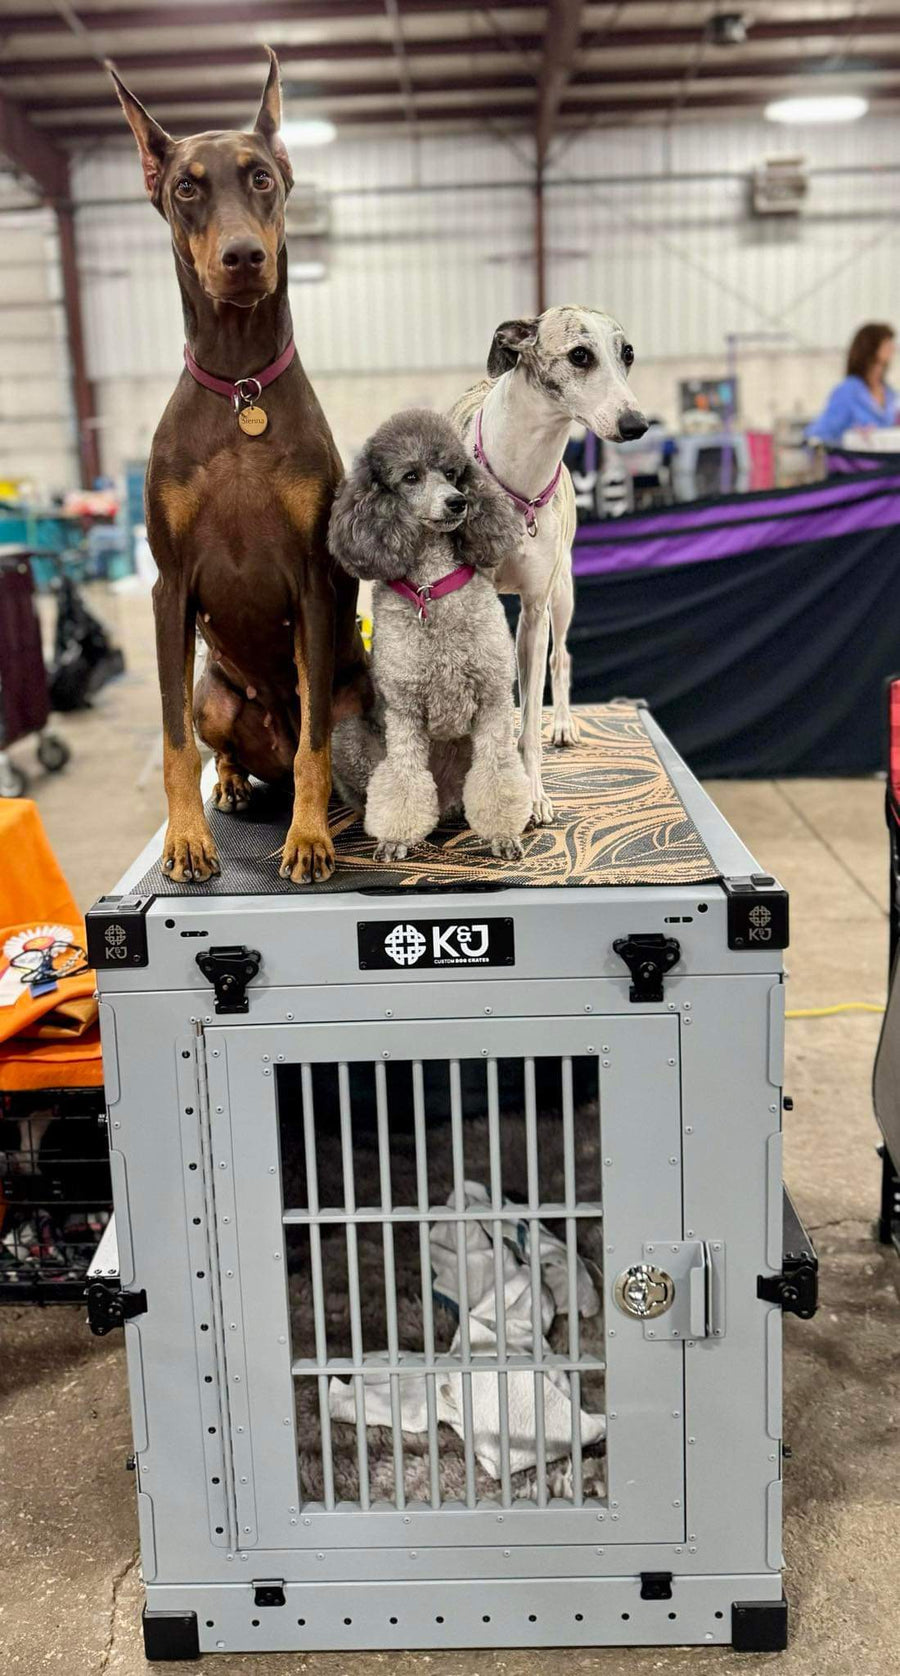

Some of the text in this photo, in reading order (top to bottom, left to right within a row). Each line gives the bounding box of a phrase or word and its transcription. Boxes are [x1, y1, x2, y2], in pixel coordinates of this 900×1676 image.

[241, 417, 265, 425] Sienna
[432, 924, 489, 958] K&J
[105, 946, 128, 960] K&J
